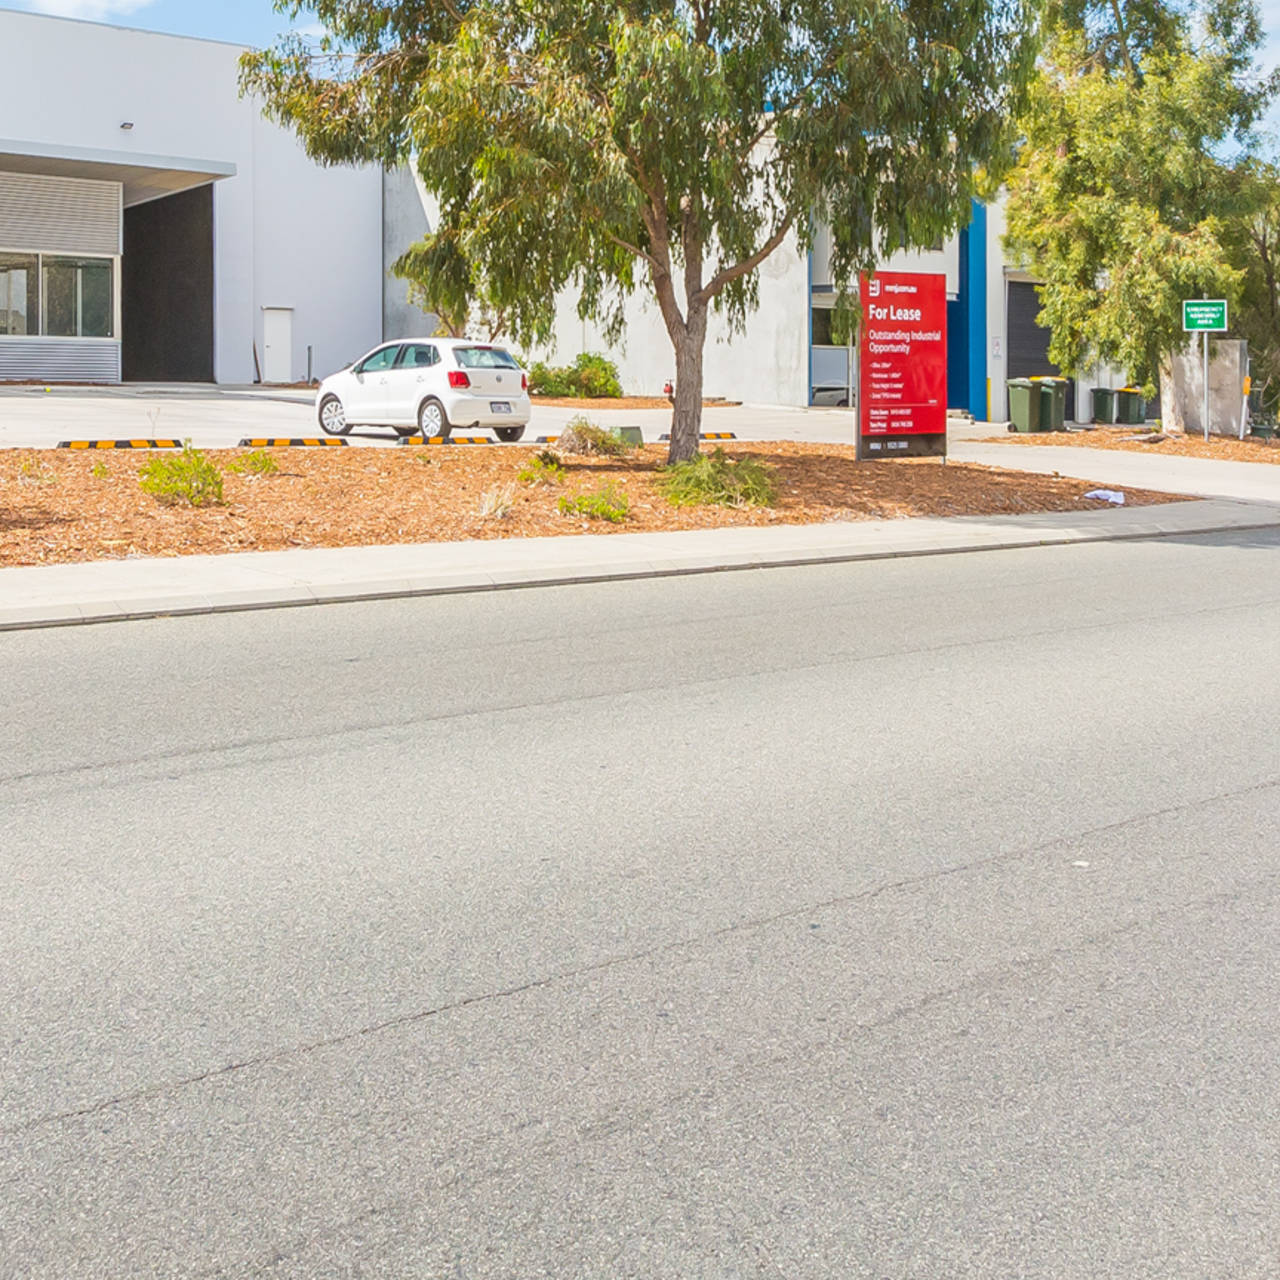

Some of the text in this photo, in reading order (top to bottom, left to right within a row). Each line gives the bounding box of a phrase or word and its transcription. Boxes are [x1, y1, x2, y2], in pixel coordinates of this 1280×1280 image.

[869, 304, 921, 321] For Lease
[869, 329, 941, 343] Outstanding Industrial
[869, 342, 910, 355] Opportunity
